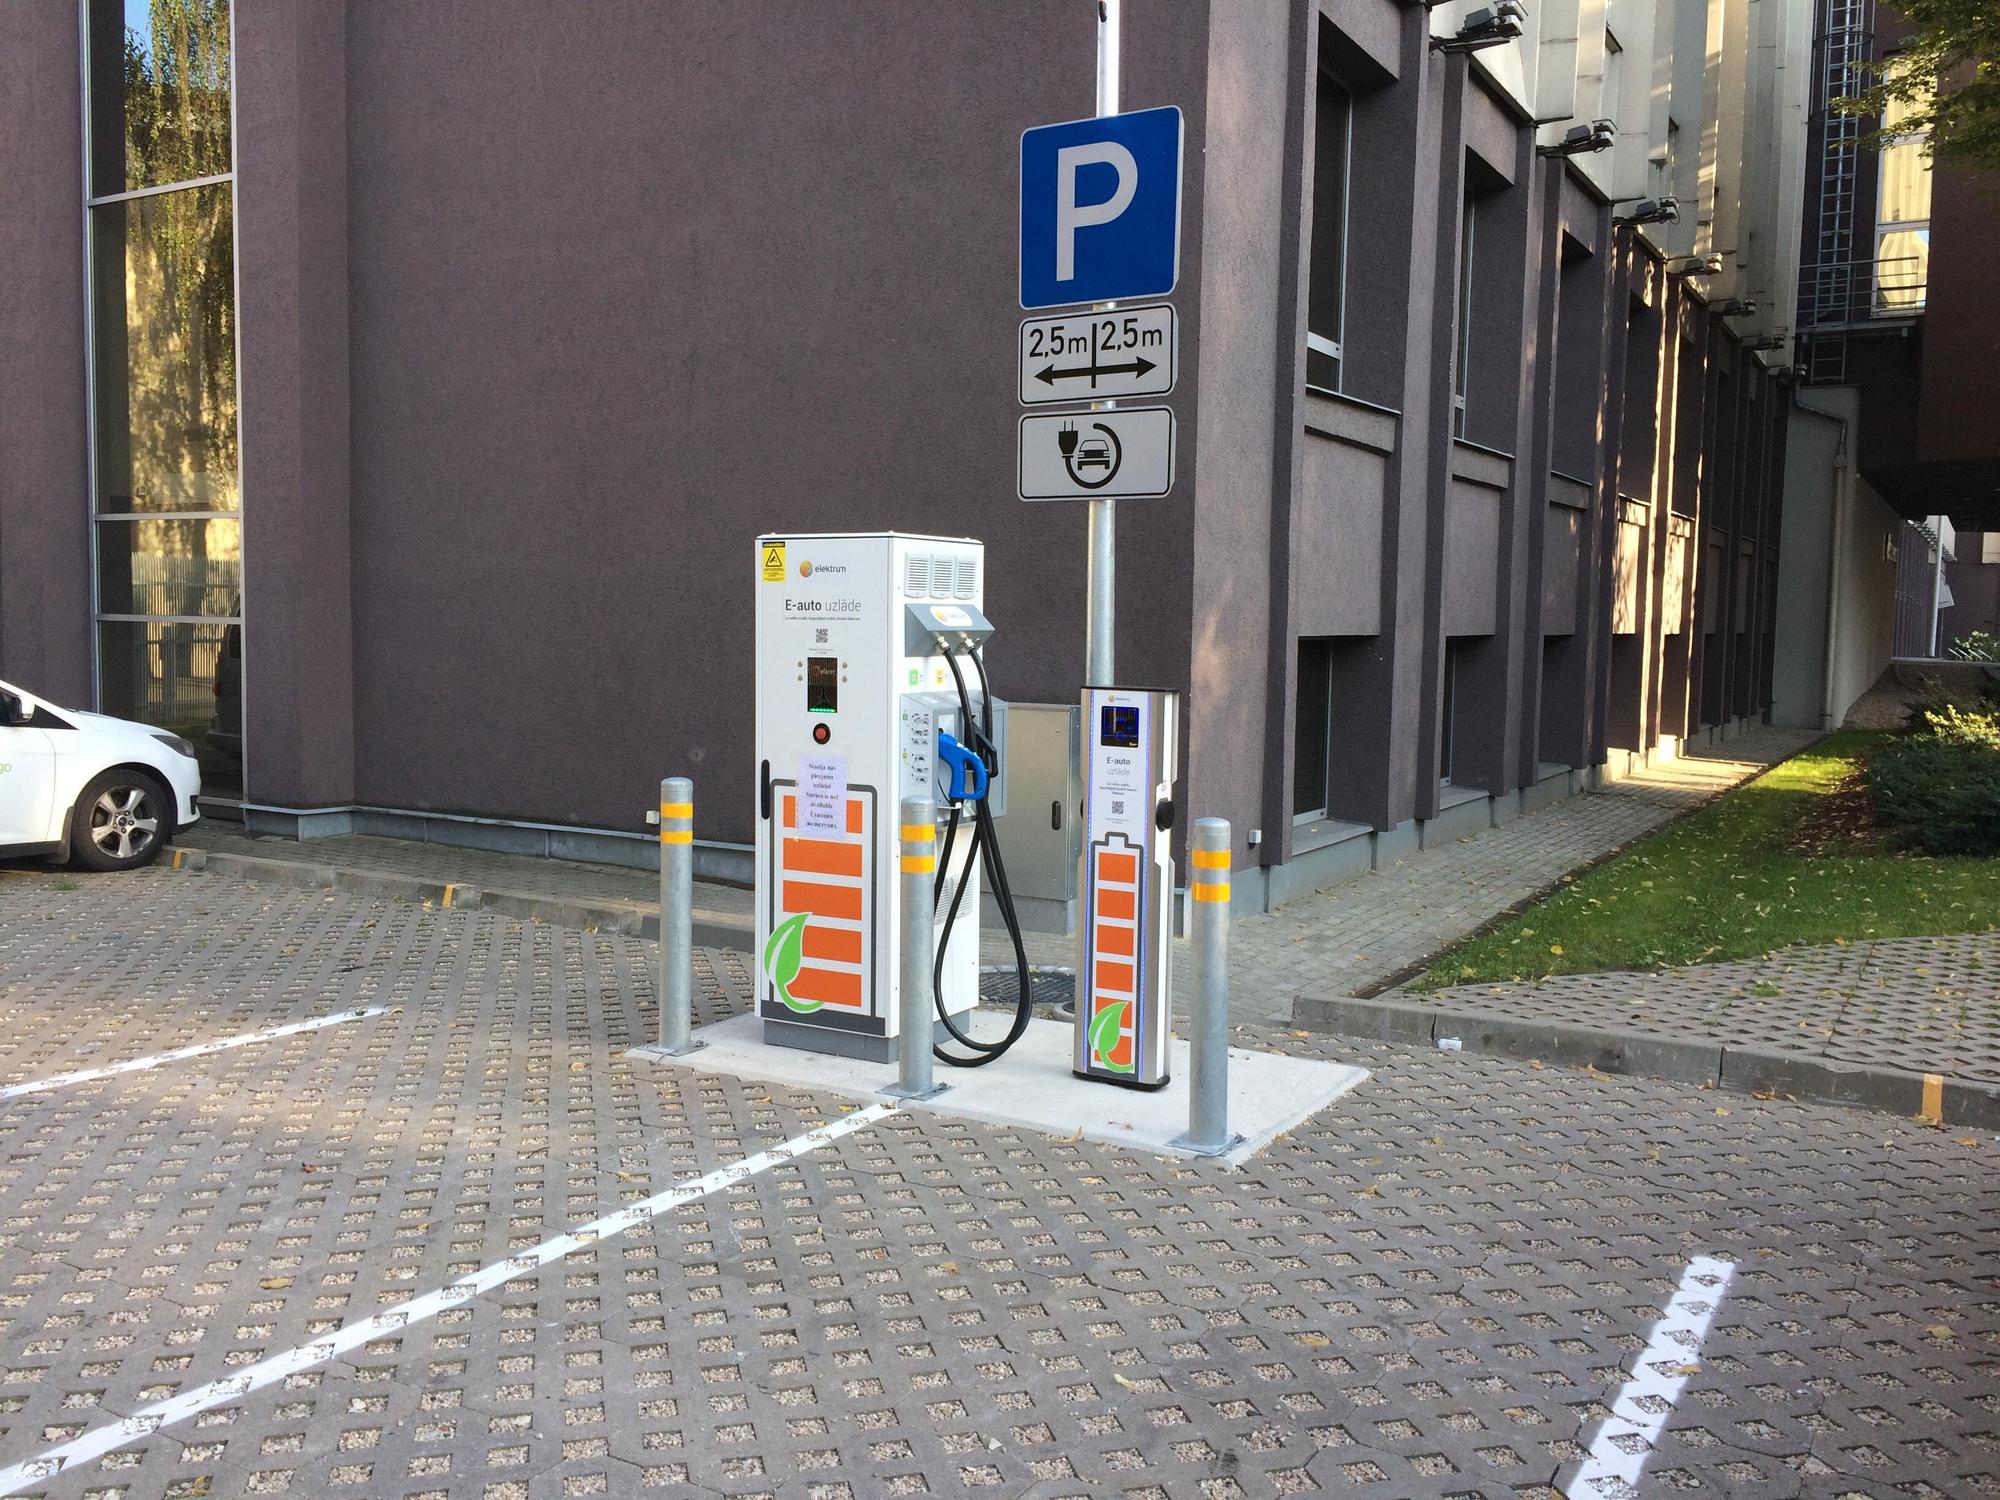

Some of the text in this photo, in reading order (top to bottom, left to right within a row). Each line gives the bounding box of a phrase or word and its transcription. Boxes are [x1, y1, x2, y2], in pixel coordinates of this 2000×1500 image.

[1056, 141, 1138, 281] P
[814, 564, 847, 573] elektrum
[785, 598, 862, 612] E-auto uzlāde
[1106, 756, 1131, 766] E-auto
